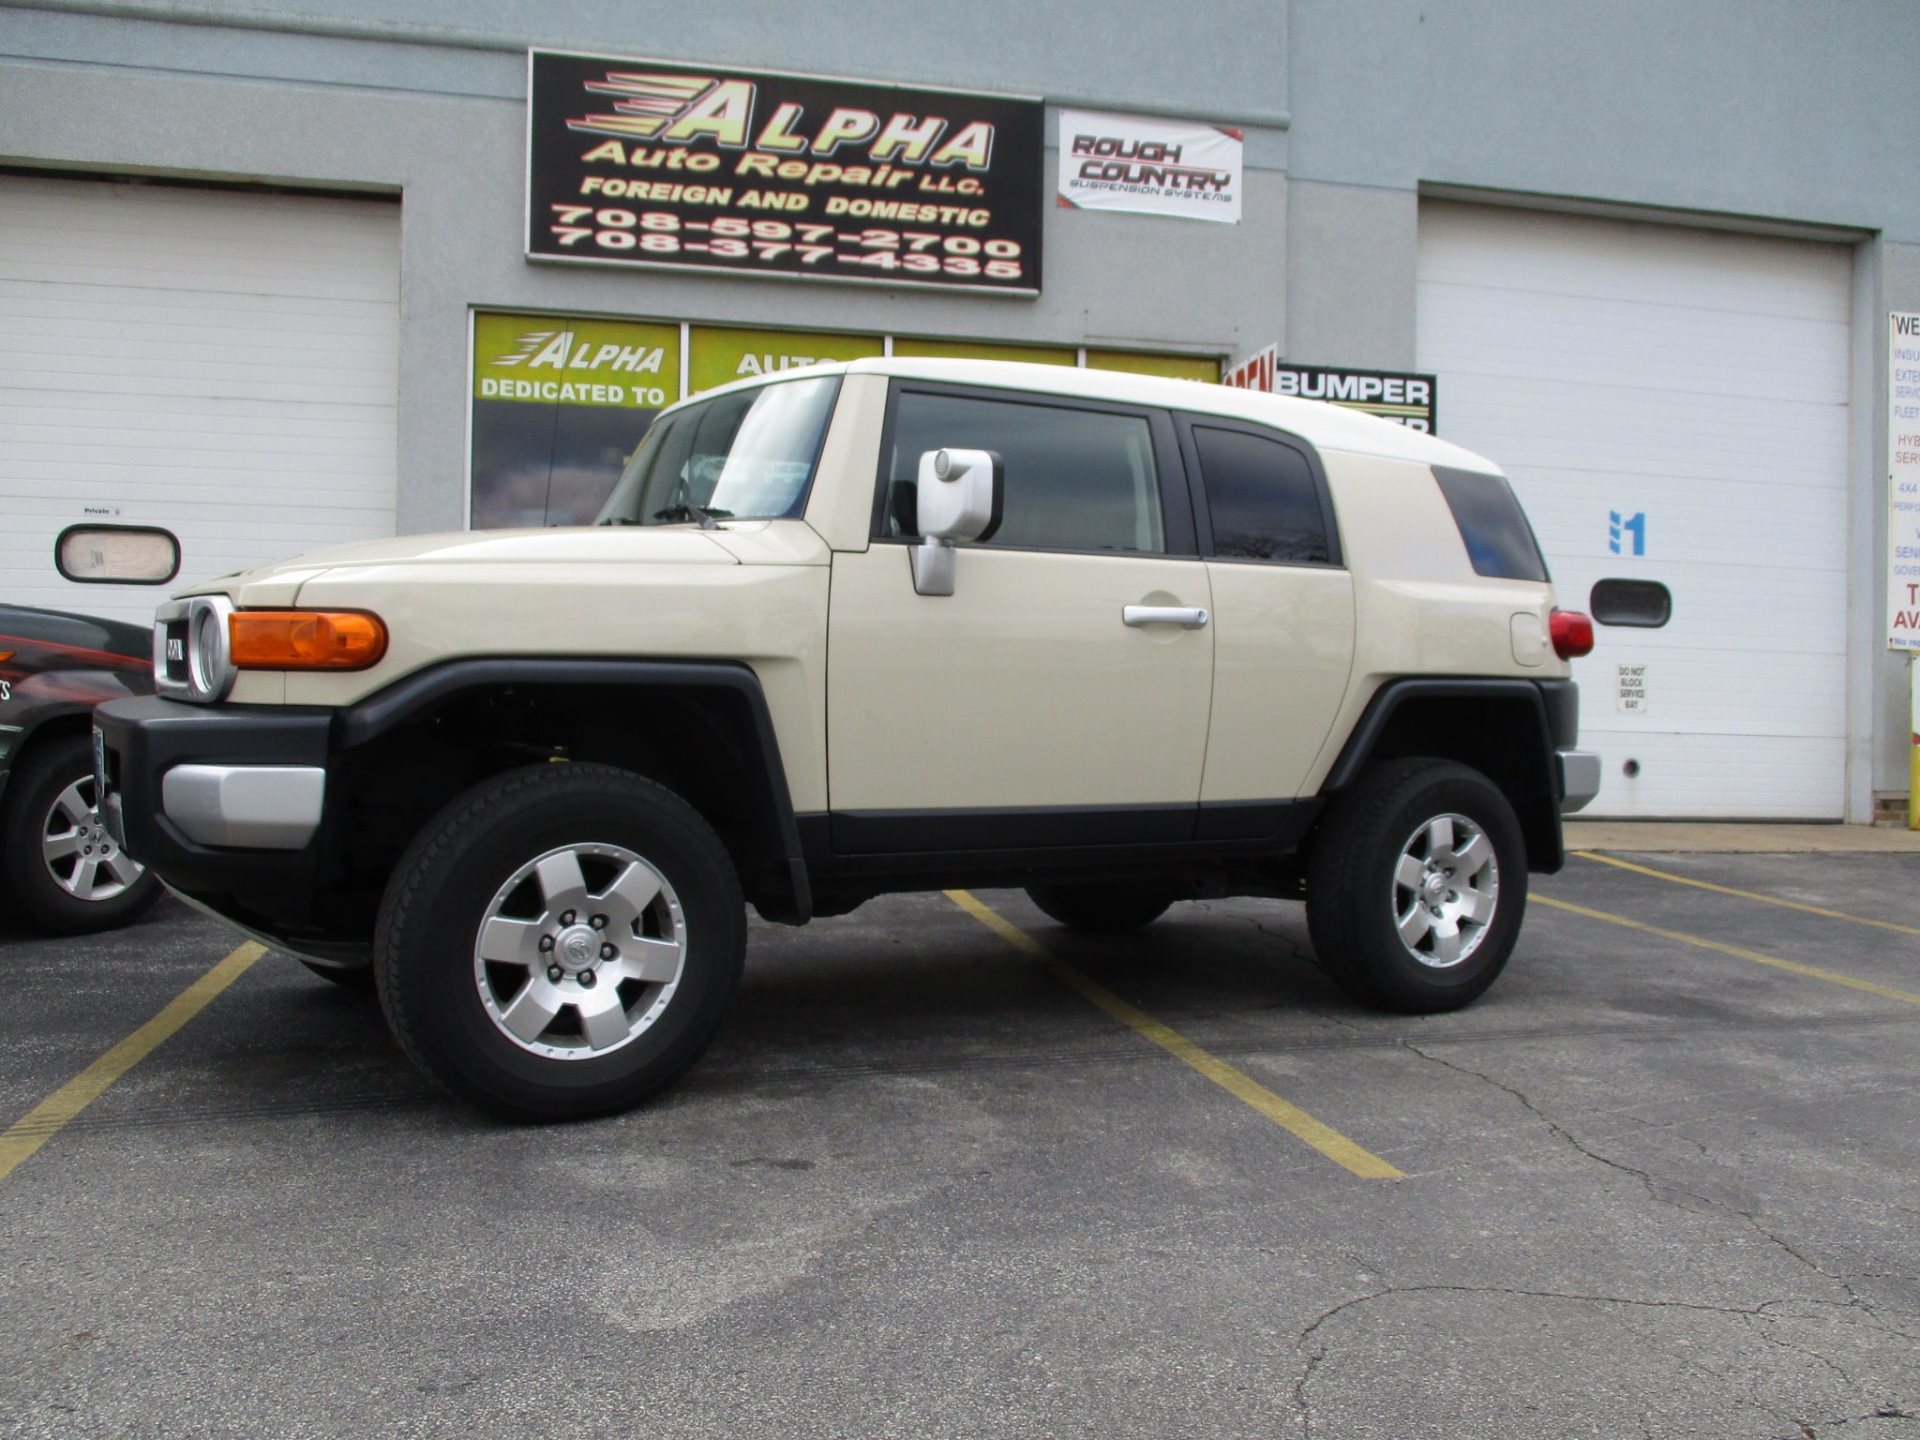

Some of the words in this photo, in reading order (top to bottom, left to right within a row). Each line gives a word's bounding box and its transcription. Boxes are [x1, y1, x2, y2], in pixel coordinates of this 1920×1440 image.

[663, 79, 994, 170] ALPHA
[1072, 134, 1183, 164] ROUGH
[581, 141, 720, 171] Auto
[735, 152, 914, 188] Repair
[919, 175, 985, 196] LLC.
[1078, 160, 1232, 192] COUNTRY
[580, 176, 733, 206] FOREIGN
[737, 189, 810, 212] AND
[824, 196, 991, 227] DOMESTIC
[1069, 179, 1160, 196] SUSPENSION
[1164, 188, 1232, 202] SYSTEMS
[550, 203, 1022, 259] 708-597-2700
[550, 225, 1022, 280] 708-377-4335
[528, 332, 664, 373] ALPHA
[481, 378, 624, 402] DEDICATED
[631, 387, 665, 404] TO
[1276, 371, 1430, 405] BUMPER
[1619, 666, 1630, 676] DO
[1631, 667, 1645, 677] NOT
[1621, 678, 1643, 687] BLOCK
